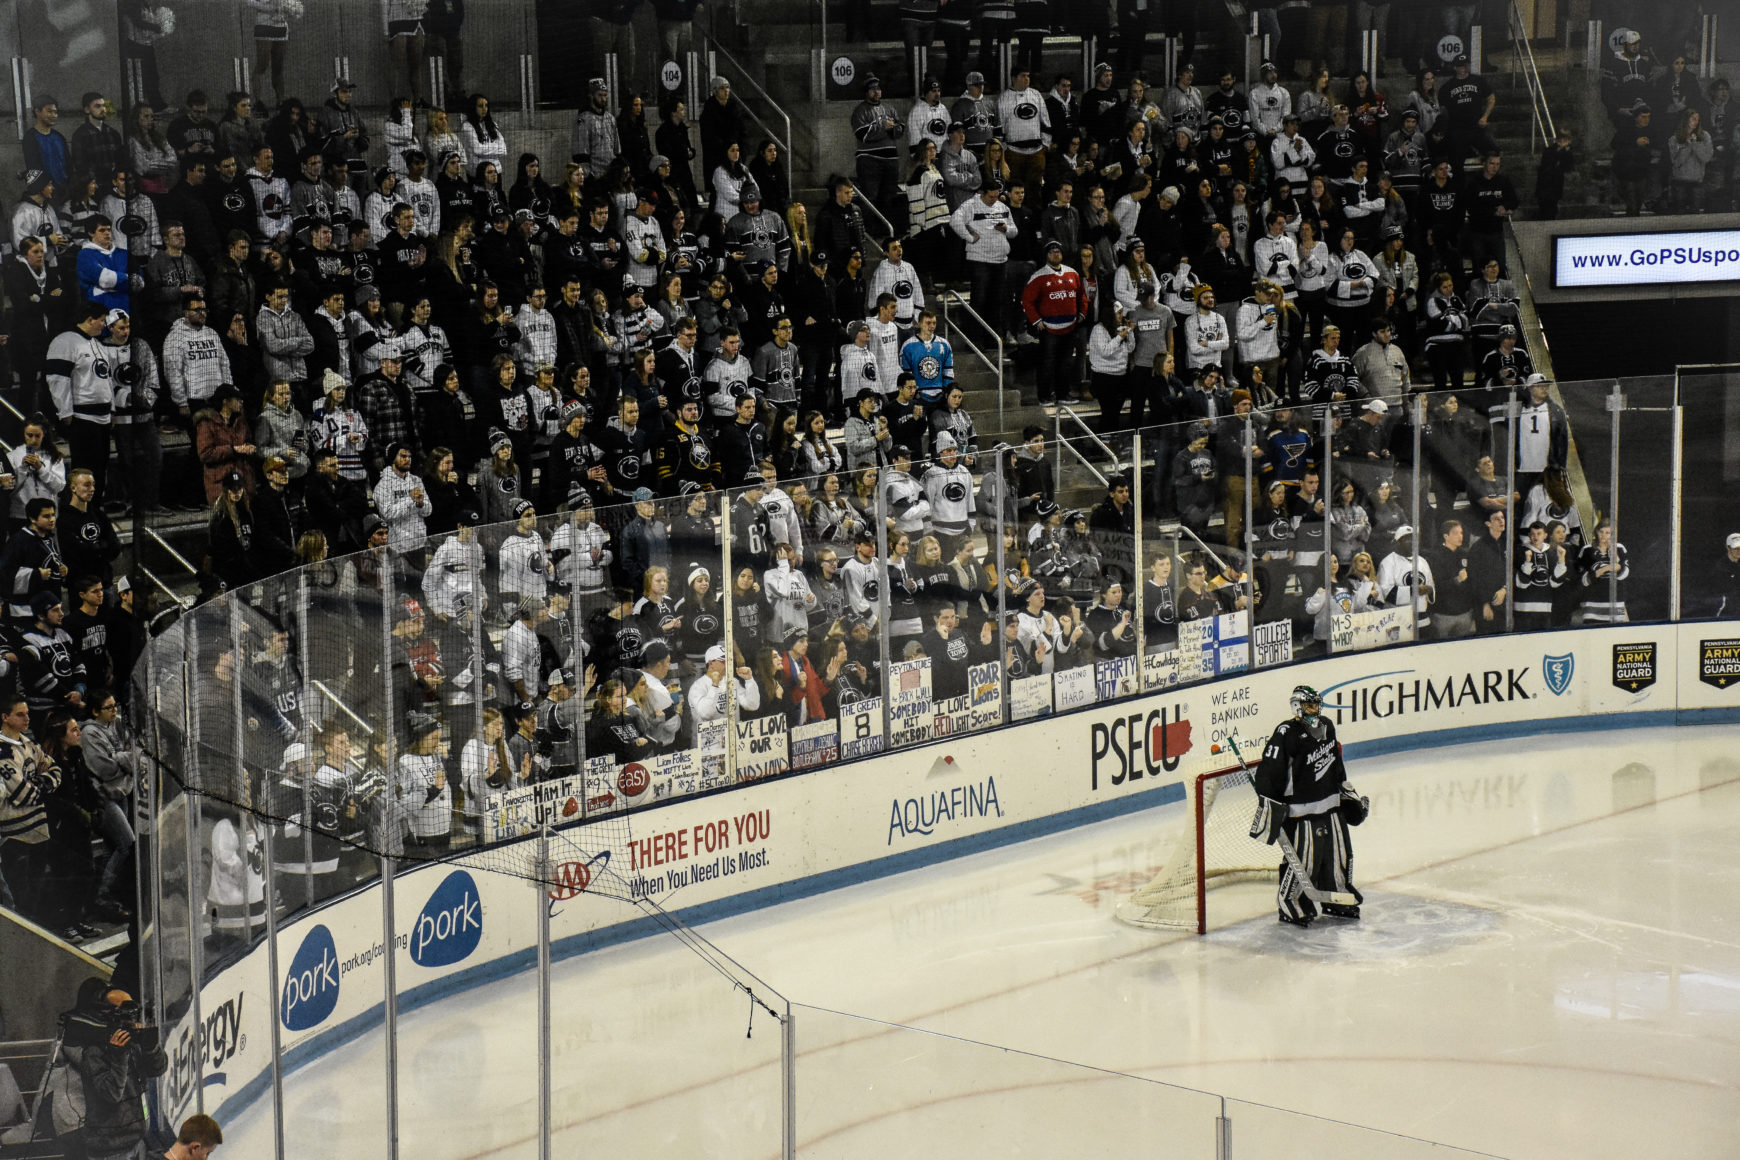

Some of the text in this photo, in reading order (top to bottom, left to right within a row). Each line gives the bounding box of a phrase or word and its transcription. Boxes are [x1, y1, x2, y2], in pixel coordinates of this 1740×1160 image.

[1441, 43, 1460, 53] 106
[664, 70, 680, 82] 104
[834, 65, 852, 77] 106
[1572, 247, 1740, 267] www.GoPSUspo
[188, 341, 215, 350] PENN
[188, 350, 218, 360] STATE
[1530, 415, 1539, 433] 1
[1202, 625, 1213, 640] 20
[1332, 614, 1351, 633] M-S
[1255, 623, 1291, 646] COLLEGE
[1258, 642, 1289, 666] SPORTS
[1617, 653, 1652, 664] ARMY
[969, 663, 1000, 688] ROAR
[1097, 656, 1137, 681] SPARTY
[1202, 657, 1214, 673] 35
[1617, 662, 1652, 670] NATIONAL
[1617, 668, 1652, 678] GUARD
[1062, 691, 1084, 705] HARD
[1097, 680, 1116, 701] NO!
[1211, 686, 1250, 706] WE ARE
[1336, 667, 1531, 725] HIGHMARK
[841, 698, 881, 717] THE GREAT
[890, 700, 931, 721] SOMEBODY
[934, 696, 970, 717] I LOVE
[971, 704, 1002, 728] Score!
[1211, 702, 1259, 725] BANKING
[736, 713, 787, 740] WE LOVE
[855, 712, 870, 739] 8
[904, 715, 919, 729] HIT
[934, 714, 970, 737] RED LIGHT
[891, 724, 931, 746] SOMEBODY
[1211, 725, 1239, 743] ON A
[750, 737, 772, 754] OUR
[841, 740, 861, 759] CHASE
[1091, 703, 1181, 791] PSECU
[1265, 745, 1280, 759] 31
[591, 757, 607, 767] ALEX
[619, 768, 646, 789] easy
[533, 784, 559, 806] HAM
[535, 800, 557, 824] UP!
[887, 775, 1001, 846] AQUAFINA
[627, 809, 771, 872] THERE FOR YOU
[630, 847, 770, 898] When You Need Us Most.
[418, 891, 480, 961] pork
[286, 947, 337, 1024] pork
